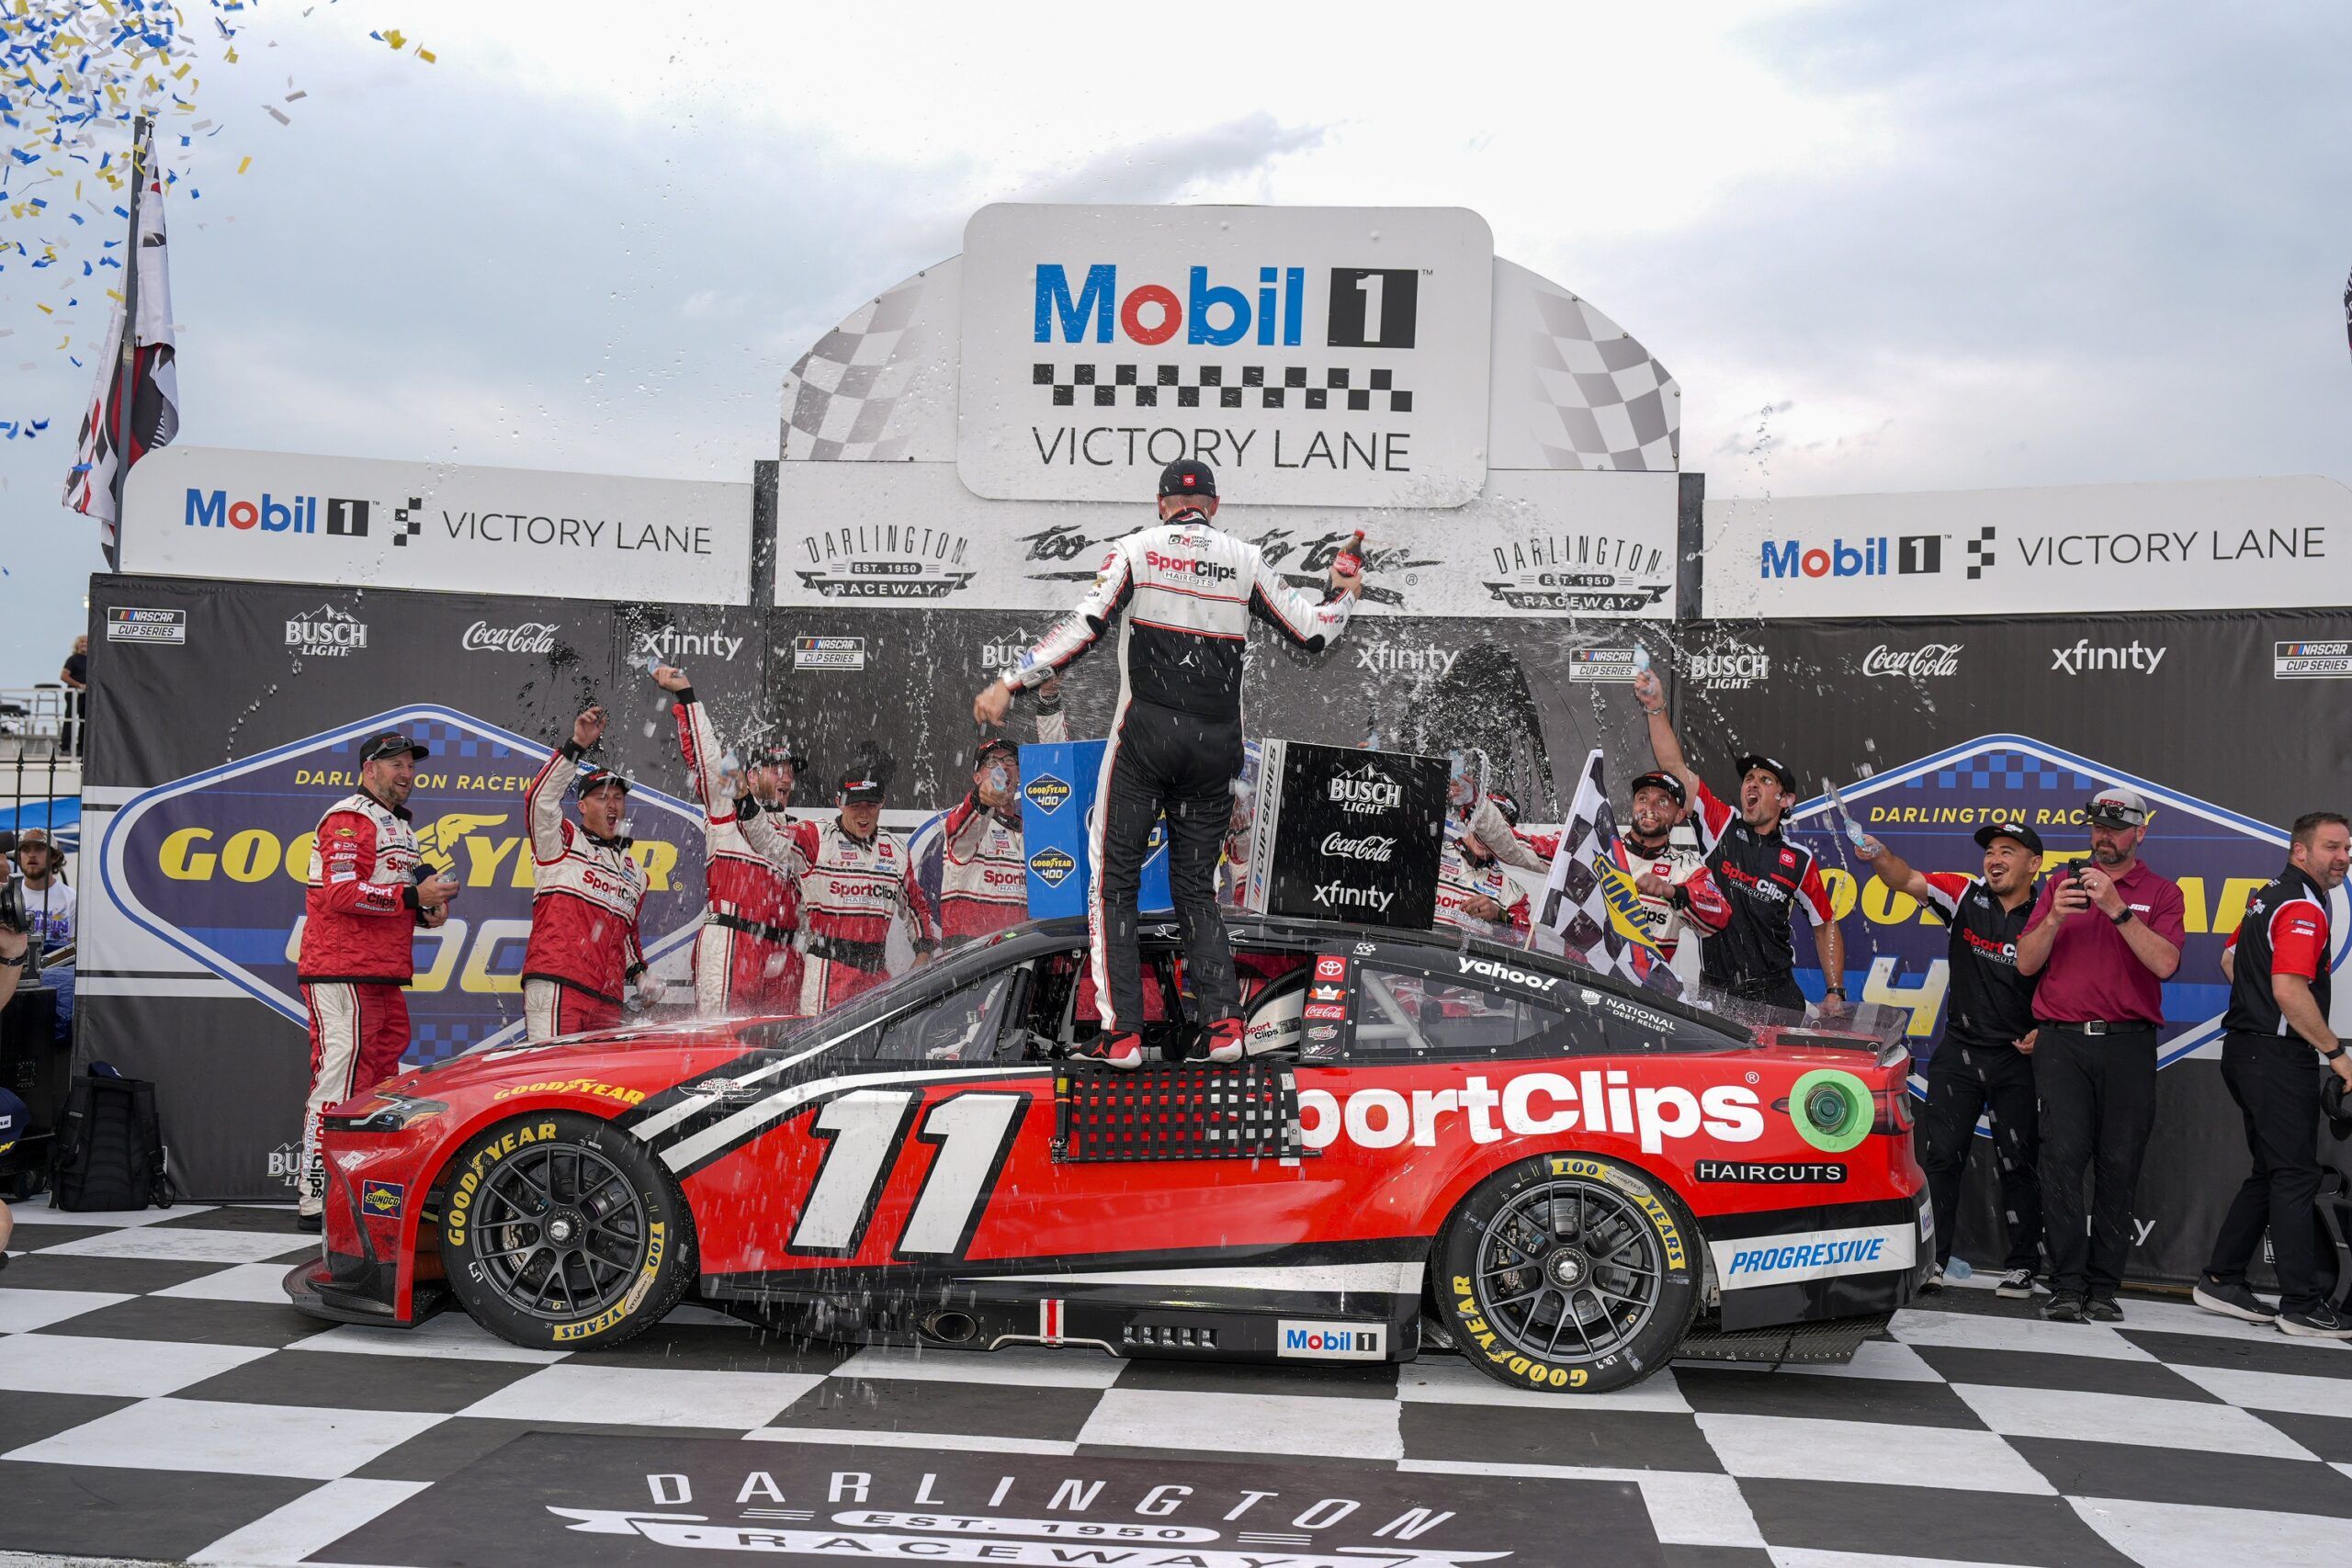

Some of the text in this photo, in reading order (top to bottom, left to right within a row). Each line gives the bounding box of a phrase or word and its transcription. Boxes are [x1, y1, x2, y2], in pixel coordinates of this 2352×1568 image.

[1034, 264, 1305, 346] Mobil
[1031, 426, 1412, 473] VICTORY LANE
[184, 488, 317, 535] Mobil
[442, 510, 713, 556] VICTORY LANE
[805, 524, 968, 564] DARLINGTON
[1493, 535, 1663, 576] DARLINGTON
[1760, 536, 1888, 580] Mobil
[2017, 526, 2326, 568] VICTORY LANE
[854, 563, 917, 573] EST. 1950
[1146, 551, 1237, 582] SportClips
[1577, 574, 1611, 586] 1950
[833, 582, 938, 596] RACEWAY
[1522, 594, 1634, 609] RACEWAY
[131, 610, 175, 623] NASCAR
[118, 625, 175, 637] CUP SERIES
[286, 619, 368, 648] BUSCH
[462, 620, 561, 654] Coca-Cola
[642, 626, 744, 661] xfinity
[817, 638, 855, 649] NASCAR
[301, 644, 347, 657] LIGHT
[804, 653, 855, 663] CUP SERIES
[982, 645, 1027, 669] BUS
[1355, 641, 1461, 675] xfinity
[1592, 650, 1633, 662] NASCAR
[1862, 644, 1964, 678] Coca-Cola
[2052, 639, 2167, 677] xfinity
[2301, 643, 2348, 656] NASCAR
[1579, 665, 1634, 676] CUP SERIES
[1690, 653, 1770, 681] BUSCH
[2286, 660, 2348, 671] CUP SERIES
[1707, 678, 1751, 690] LIGHT
[295, 770, 538, 791] DARLION RACEW
[1027, 784, 1068, 795] GOODYEAR
[1329, 778, 1403, 809] BUSCH
[1037, 795, 1058, 806] 400
[1255, 745, 1277, 874] CUP SERIES
[1341, 802, 1385, 816] LIGHT
[1870, 806, 2157, 825] DARLINGTON RACY
[1320, 831, 1397, 862] Coca-Cola
[1032, 858, 1072, 868] GOODYEAR
[1042, 869, 1063, 879] 400
[357, 882, 393, 897] Sport
[830, 880, 898, 901] SportClips
[1313, 880, 1394, 912] xfinity
[1721, 861, 1788, 904] SportClips
[367, 893, 397, 908] Clips
[1457, 956, 1559, 991] yahoo!
[1306, 1005, 1343, 1019] Coca-Cola
[1606, 998, 1677, 1031] NATIONAL
[1611, 1009, 1667, 1033] DEBT RELIEF
[1245, 1021, 1272, 1035] Sport
[1254, 1028, 1279, 1041] Clips
[493, 1078, 646, 1106] GOODYEAR
[1297, 1069, 1763, 1155] portClips
[447, 1122, 557, 1247] GOODYEAR
[790, 1089, 1021, 1255] 11
[1700, 1163, 1841, 1181] HAIRCUTS
[367, 1194, 400, 1206] SUNOCO
[1560, 1161, 1682, 1261] 100 YEARS
[1729, 1237, 1885, 1274] PROGRESSIVE
[560, 1230, 662, 1339] 100 YEARS
[1286, 1329, 1351, 1351] Mobil
[1452, 1275, 1589, 1388] GOODYEAR
[646, 1471, 1457, 1541] DARLINGTON
[862, 1514, 1187, 1540] EST. 1950
[737, 1532, 1296, 1568] RACEWAY
